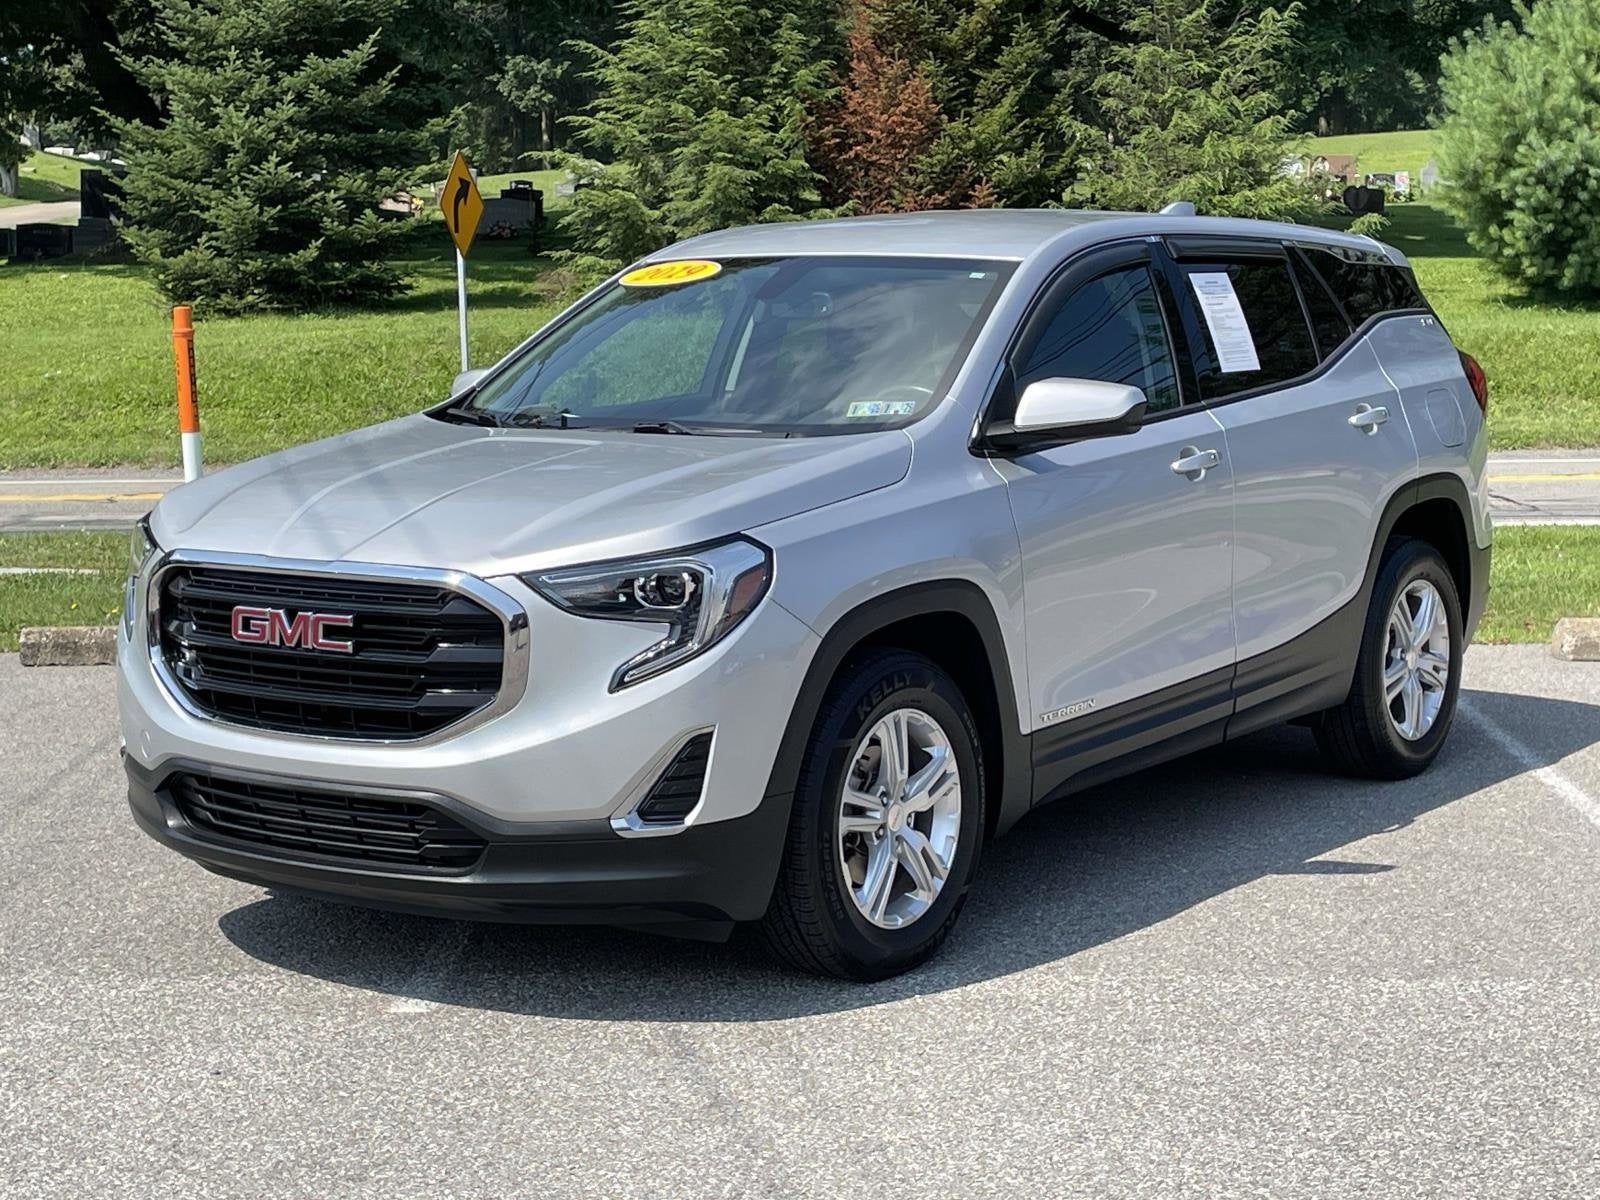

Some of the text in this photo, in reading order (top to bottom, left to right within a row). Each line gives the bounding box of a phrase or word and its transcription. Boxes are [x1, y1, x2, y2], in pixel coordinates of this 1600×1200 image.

[232, 606, 353, 653] GMC
[856, 672, 913, 722] KELLY
[1041, 698, 1096, 722] TERRAIN
